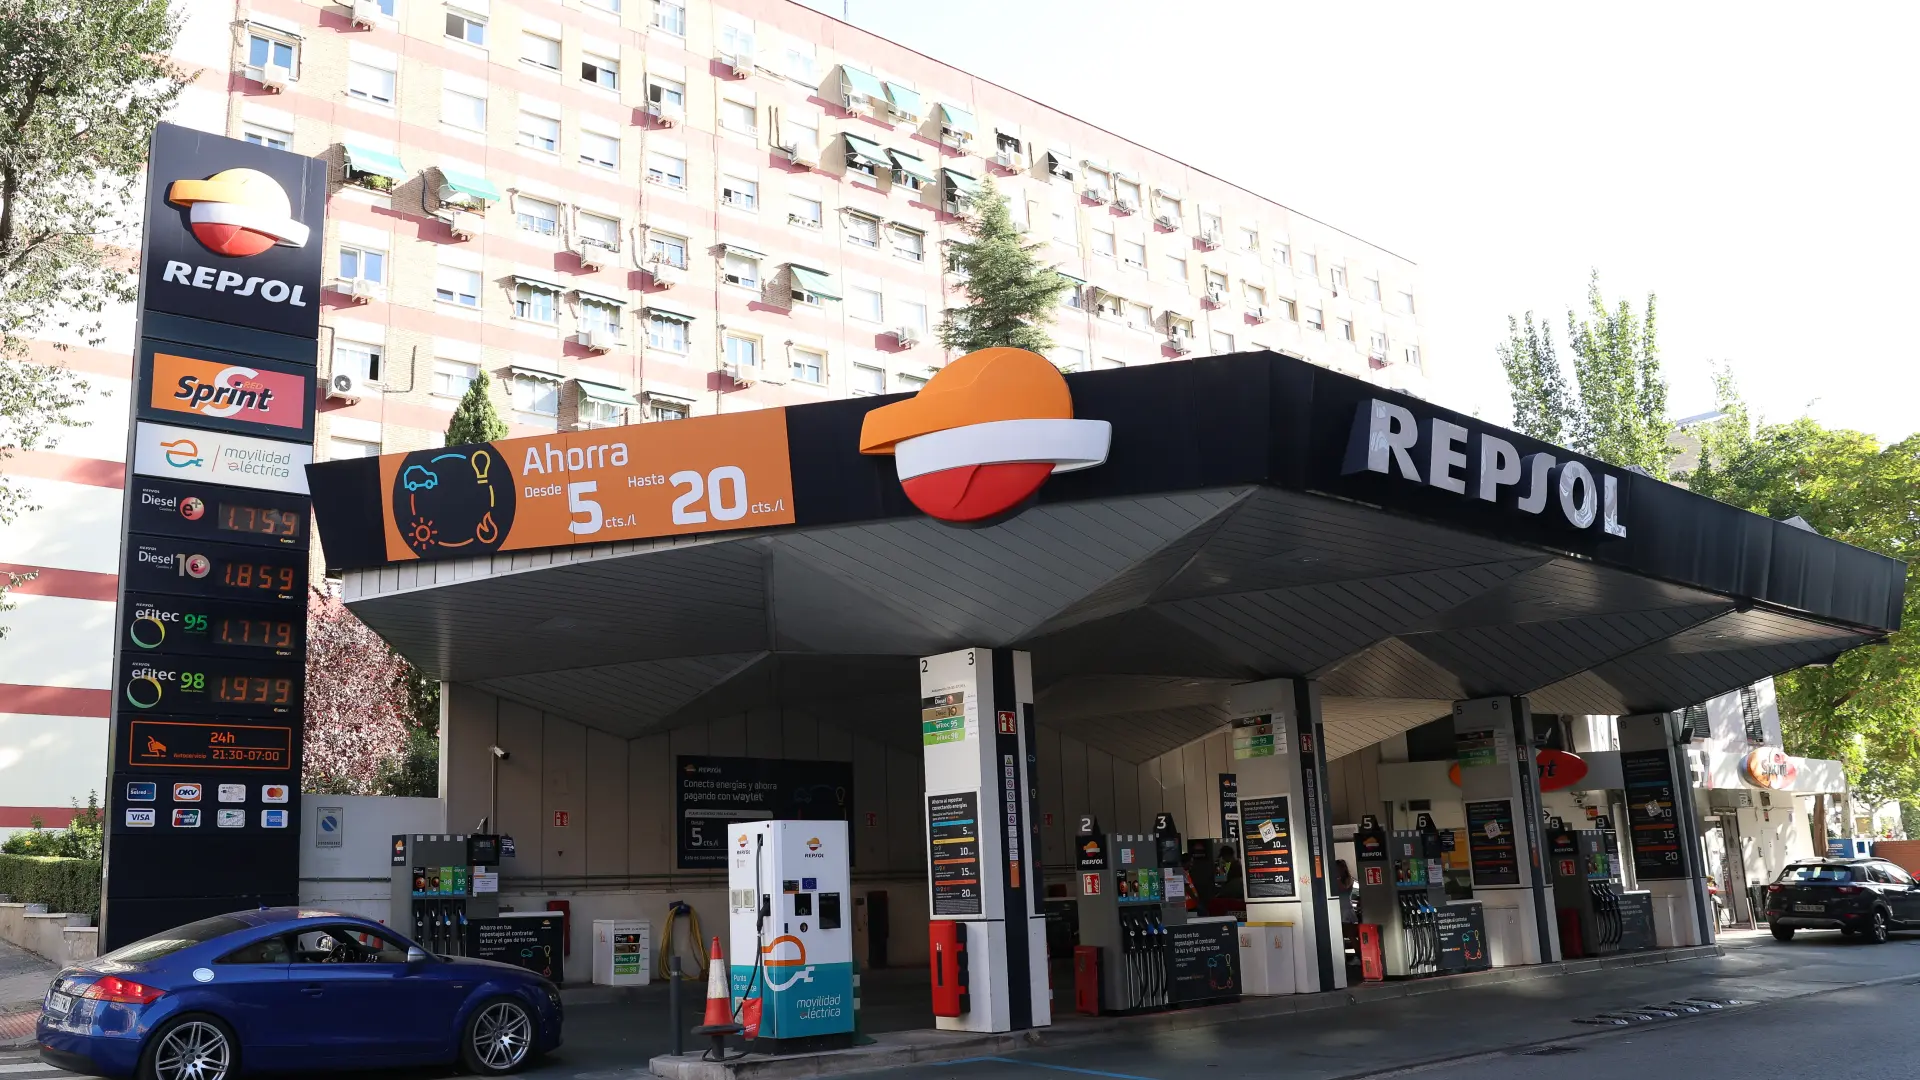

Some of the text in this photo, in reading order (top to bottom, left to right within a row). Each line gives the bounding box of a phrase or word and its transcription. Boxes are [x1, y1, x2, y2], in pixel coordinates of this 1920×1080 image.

[162, 260, 307, 307] REPSOL
[243, 382, 264, 390] RED
[173, 375, 275, 413] Sprint
[223, 447, 292, 465] movilidad
[522, 442, 629, 476] Ahorra
[227, 461, 290, 478] eléctrica
[1367, 398, 1627, 538] REPSOL
[524, 465, 785, 535] Desde 5 cts./l Hasta 20 cts./l
[141, 493, 176, 508] Diesel
[228, 506, 295, 535] 1.759
[138, 550, 174, 565] Diesel
[225, 563, 294, 591] 1.859
[135, 608, 291, 647] efitec 95 1.779
[967, 652, 975, 665] 3
[921, 660, 929, 673] 2
[131, 667, 290, 703] efitec 98 1.939
[1456, 705, 1463, 715] 5
[1492, 700, 1499, 710] 6
[1653, 716, 1660, 726] 9
[210, 732, 235, 743] 24h
[212, 750, 280, 762] 21:30-07:00
[684, 779, 778, 791] Conecta energías y ahorra
[684, 792, 716, 802] pagando
[717, 792, 731, 801] con
[1662, 788, 1669, 796] 5
[131, 813, 150, 821] VISA
[1156, 815, 1167, 829] 3
[1363, 817, 1373, 829] 5
[1418, 816, 1427, 828] 6
[1597, 817, 1605, 828] 9
[1081, 817, 1092, 832] 2
[1551, 818, 1560, 829] 8
[691, 826, 703, 847] 5
[962, 826, 968, 835] 5
[1663, 830, 1675, 840] 15
[1272, 840, 1281, 848] 10
[960, 847, 969, 856] 10
[1665, 852, 1678, 861] 20
[1274, 858, 1282, 866] 15
[961, 867, 970, 876] 15
[1274, 875, 1284, 883] 20
[962, 888, 971, 898] 20
[797, 994, 841, 1009] movilidad
[800, 1006, 841, 1020] eléctrica
